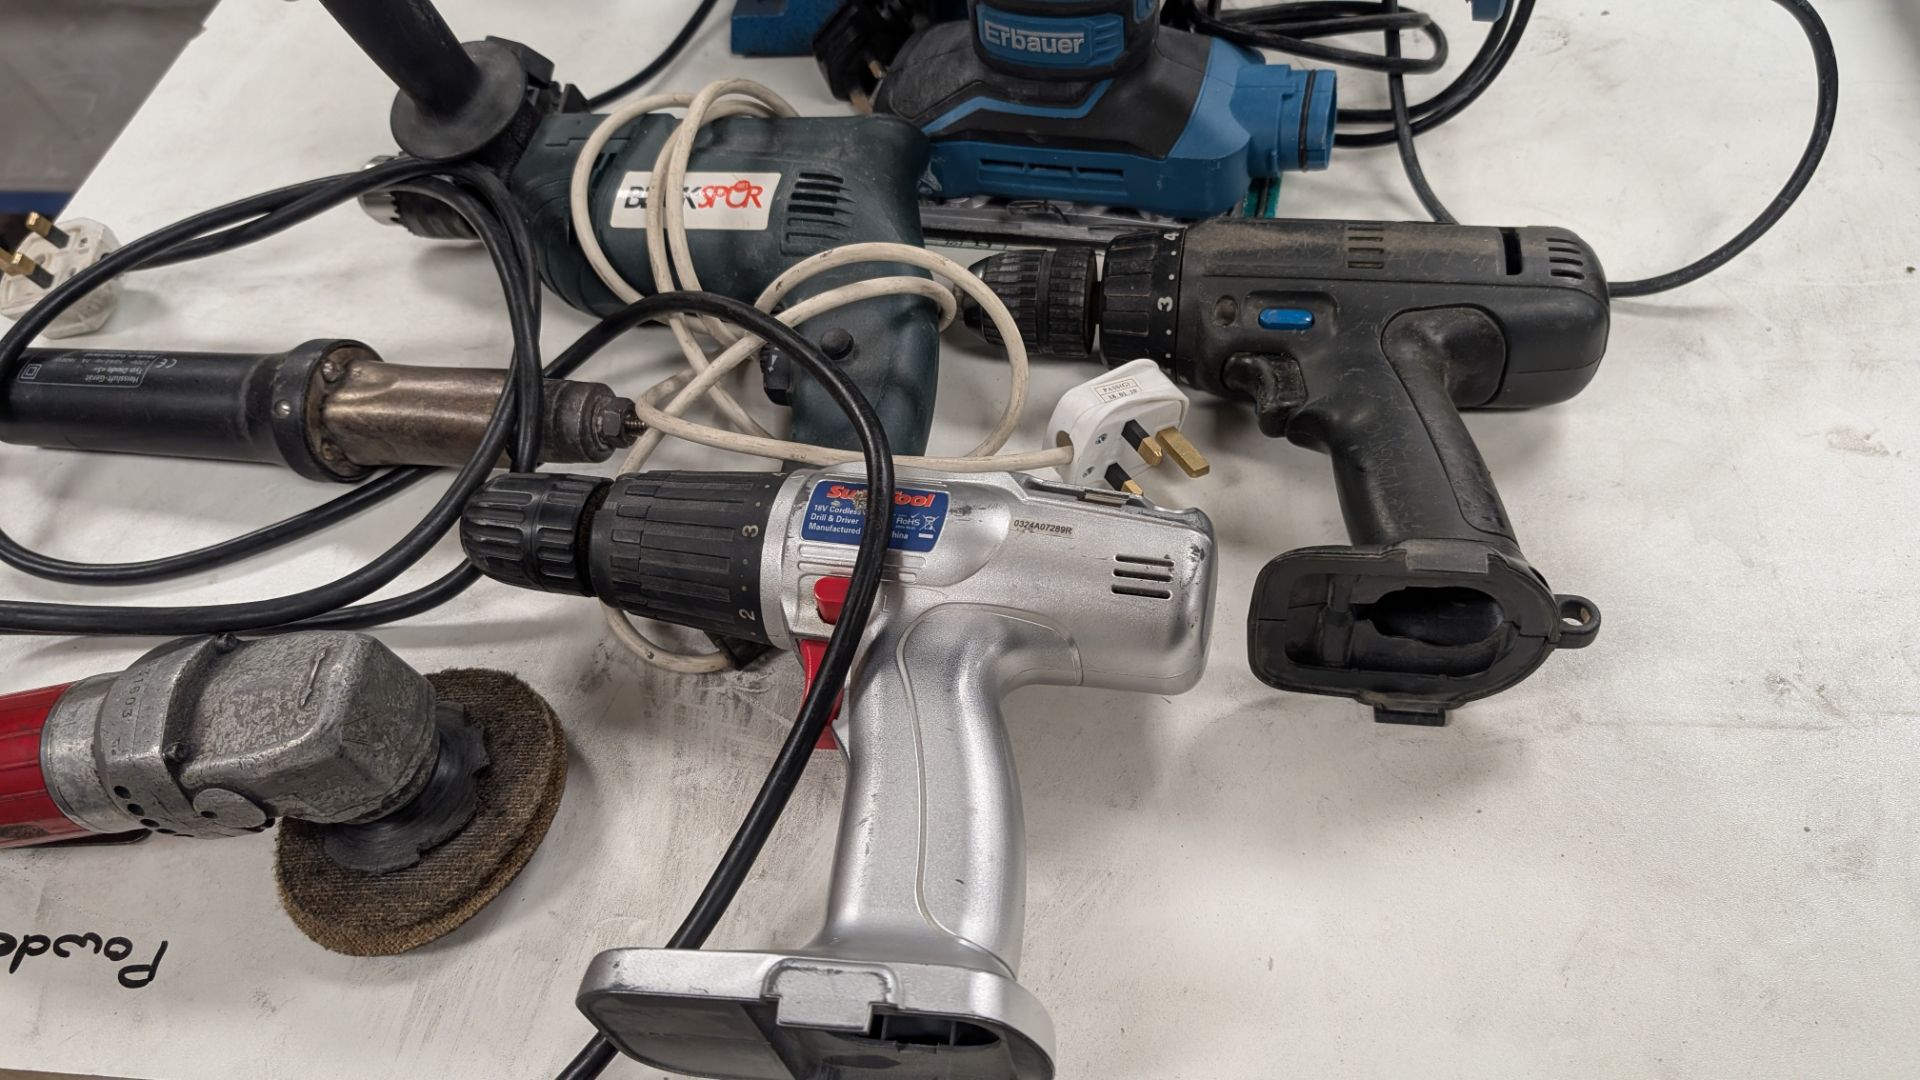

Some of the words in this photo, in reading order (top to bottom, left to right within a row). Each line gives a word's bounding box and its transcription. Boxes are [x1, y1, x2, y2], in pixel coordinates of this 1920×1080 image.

[984, 20, 1085, 54] Erbauer
[1163, 232, 1179, 241] 4
[1157, 296, 1173, 312] 3
[814, 504, 828, 513] 18V
[810, 513, 827, 522] Drill
[828, 514, 835, 523] &
[836, 515, 860, 525] Driver
[895, 516, 921, 527] RoHS
[741, 524, 759, 538] 3
[808, 522, 861, 535] Manufactured
[891, 530, 909, 540] hina
[738, 607, 757, 622] 2
